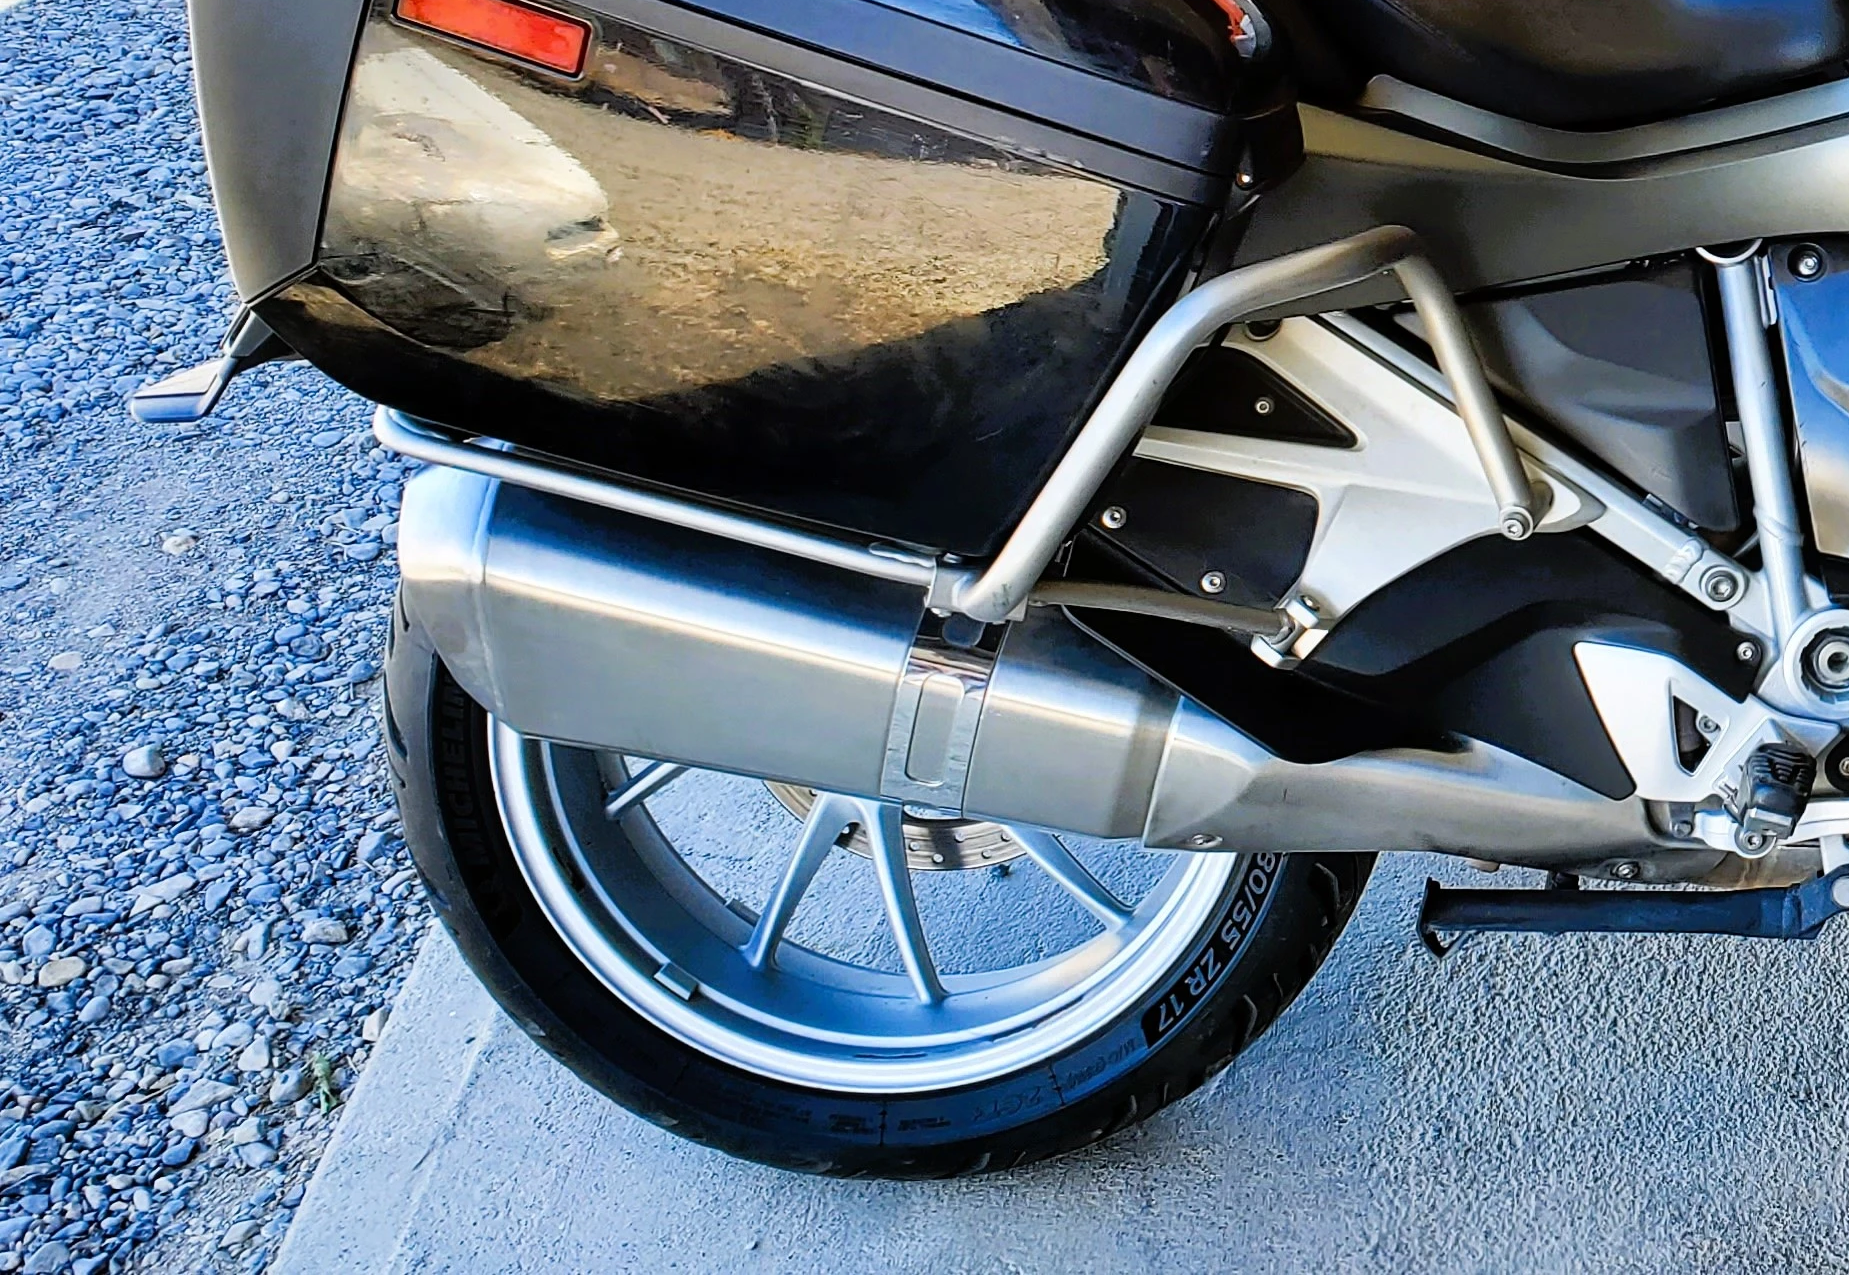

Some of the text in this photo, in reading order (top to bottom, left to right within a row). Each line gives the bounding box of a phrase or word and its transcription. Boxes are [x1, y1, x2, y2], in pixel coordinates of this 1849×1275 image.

[1157, 851, 1277, 1033] 80/55 ZR 17
